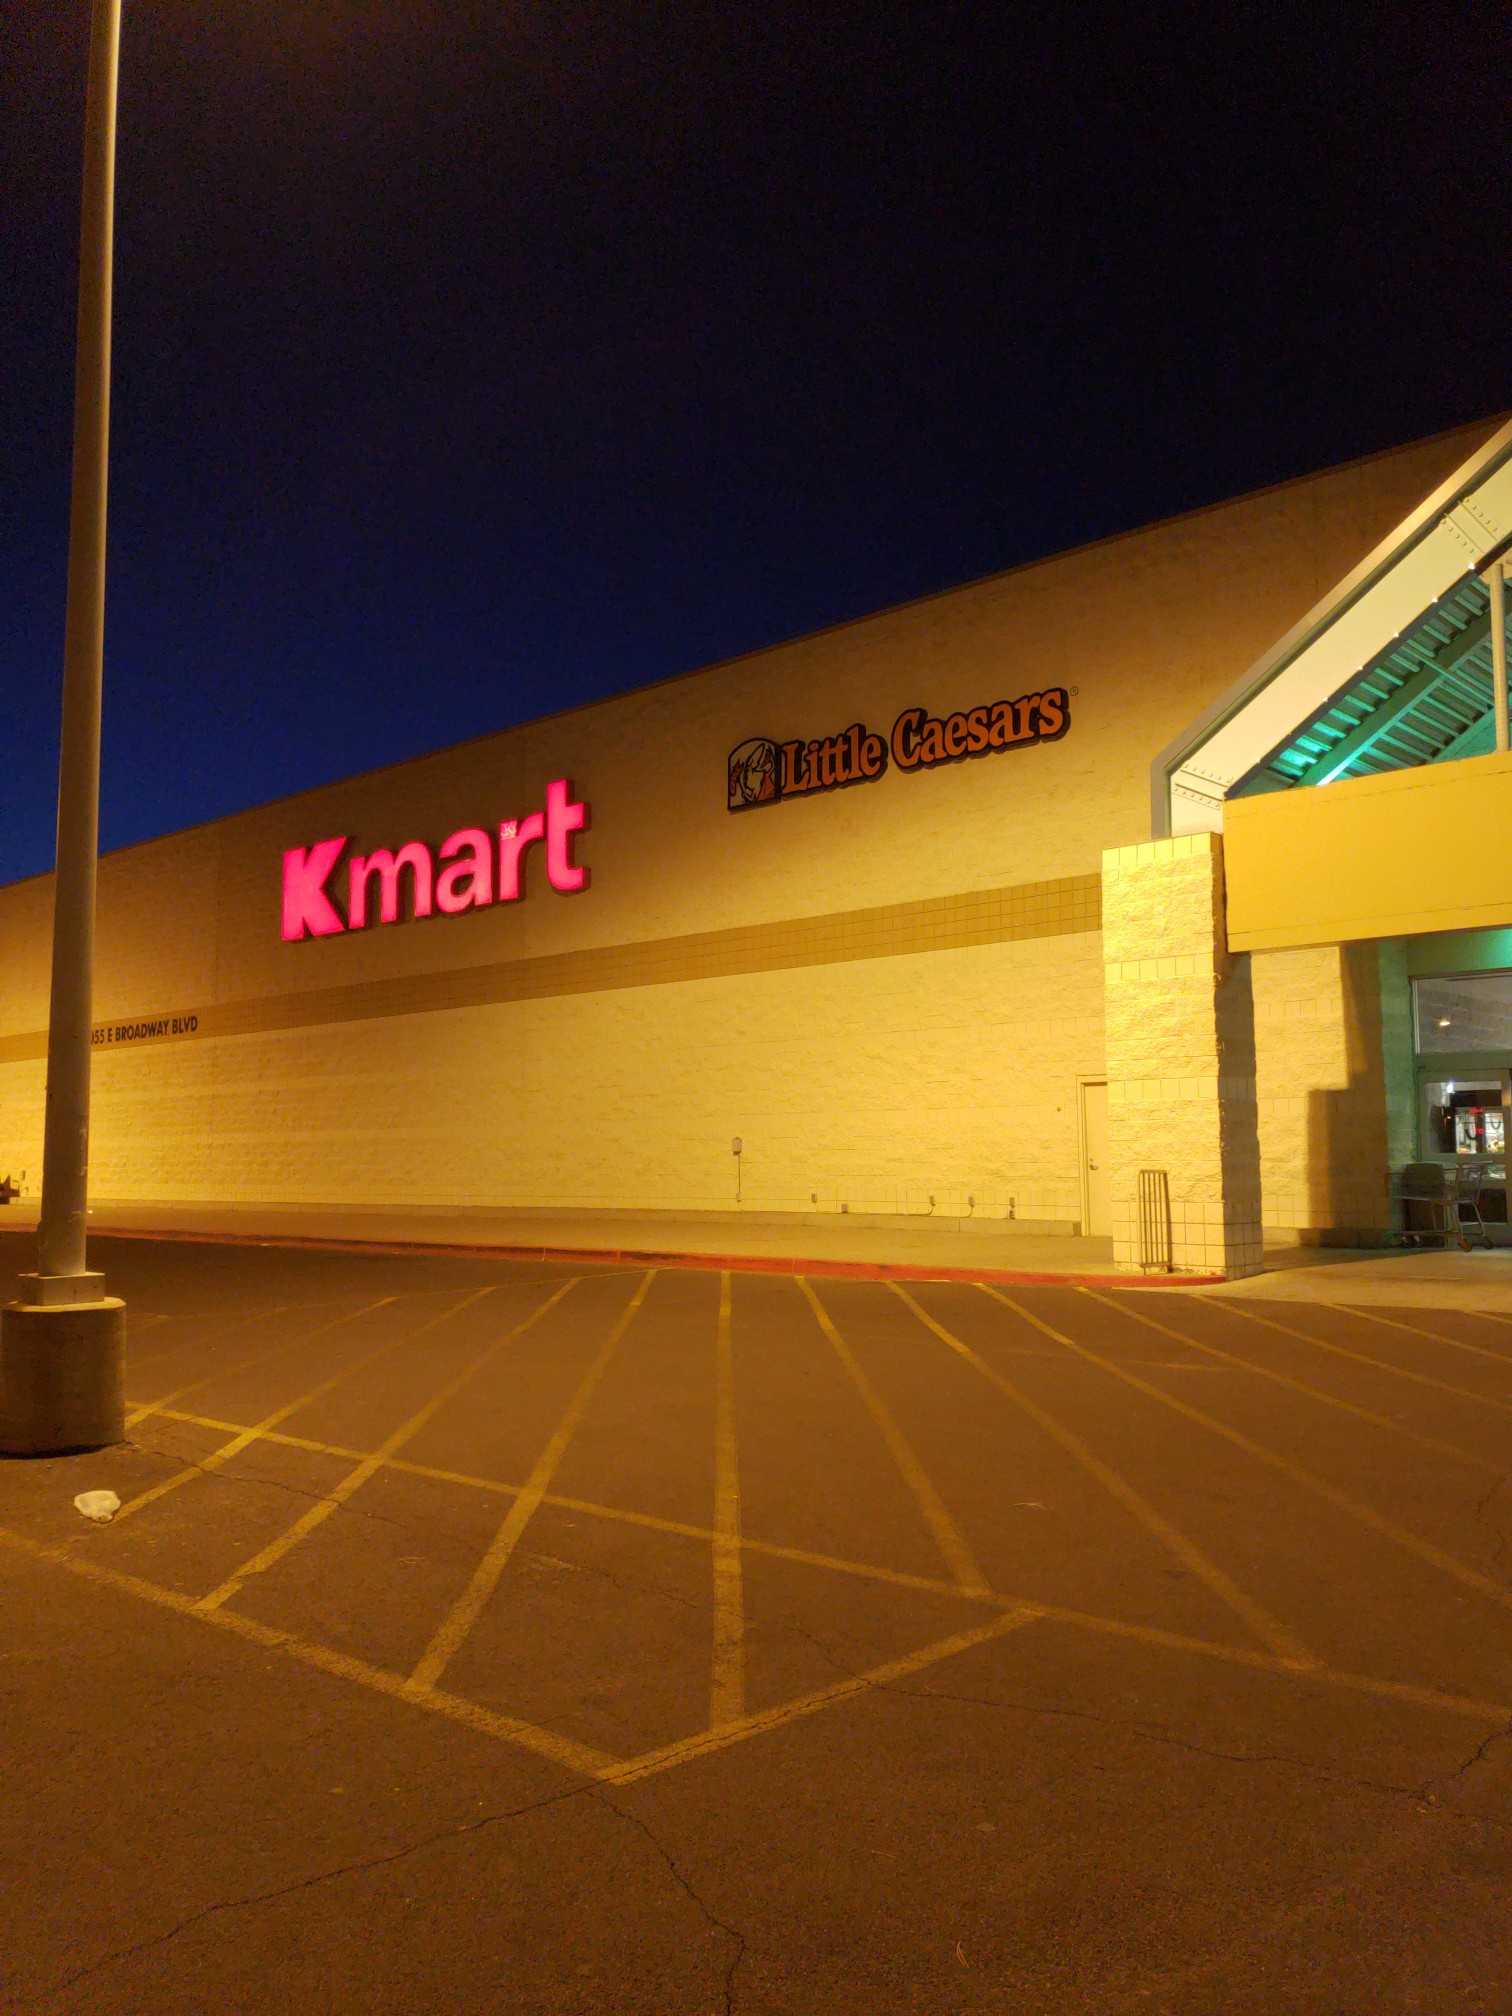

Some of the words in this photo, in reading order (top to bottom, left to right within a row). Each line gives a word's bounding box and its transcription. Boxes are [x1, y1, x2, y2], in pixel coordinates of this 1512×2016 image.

[781, 724, 888, 799] Little
[891, 688, 1070, 773] Caesars
[281, 780, 587, 941] Kmart
[107, 1028, 113, 1042] E
[115, 1021, 169, 1041] BROADWAY
[172, 1016, 198, 1034] BLVD
